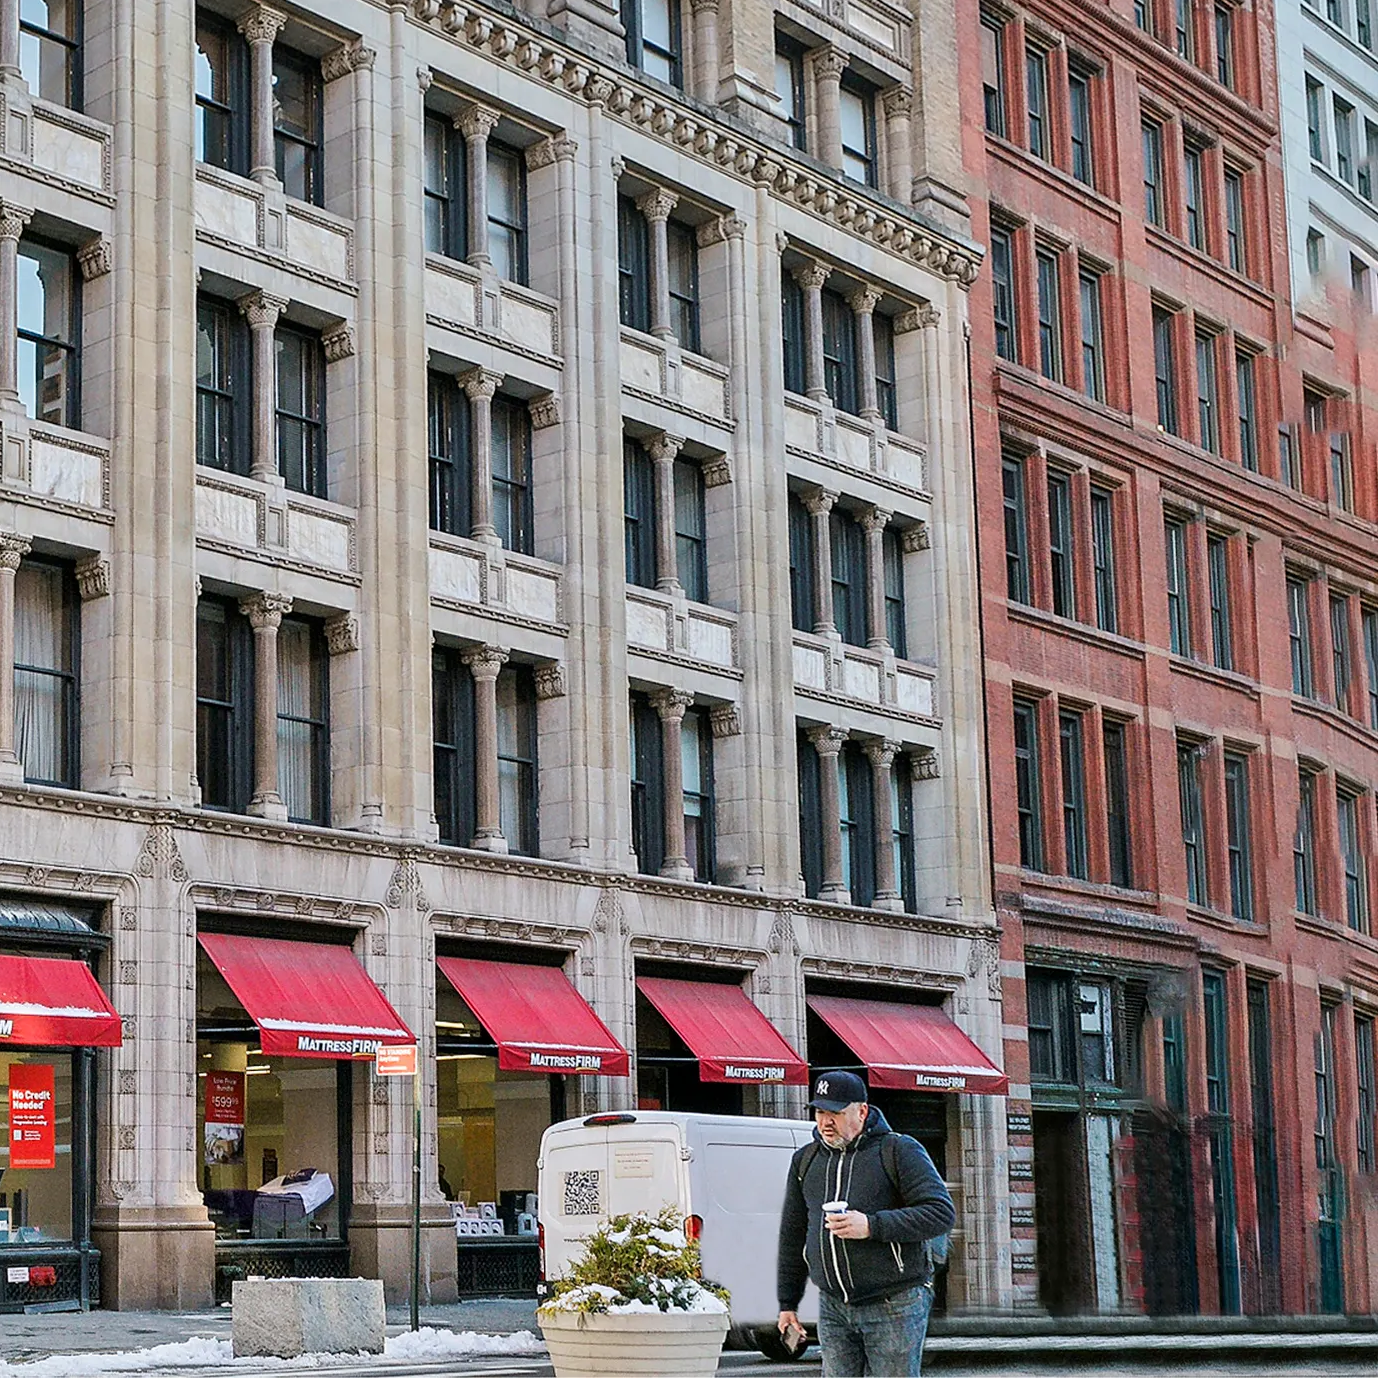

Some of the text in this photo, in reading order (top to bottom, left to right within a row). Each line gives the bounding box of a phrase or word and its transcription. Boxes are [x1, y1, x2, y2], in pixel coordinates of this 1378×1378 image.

[530, 1052, 601, 1069] MATTRESSFIRM
[12, 1090, 51, 1101] No Credit
[12, 1100, 44, 1110] Needed
